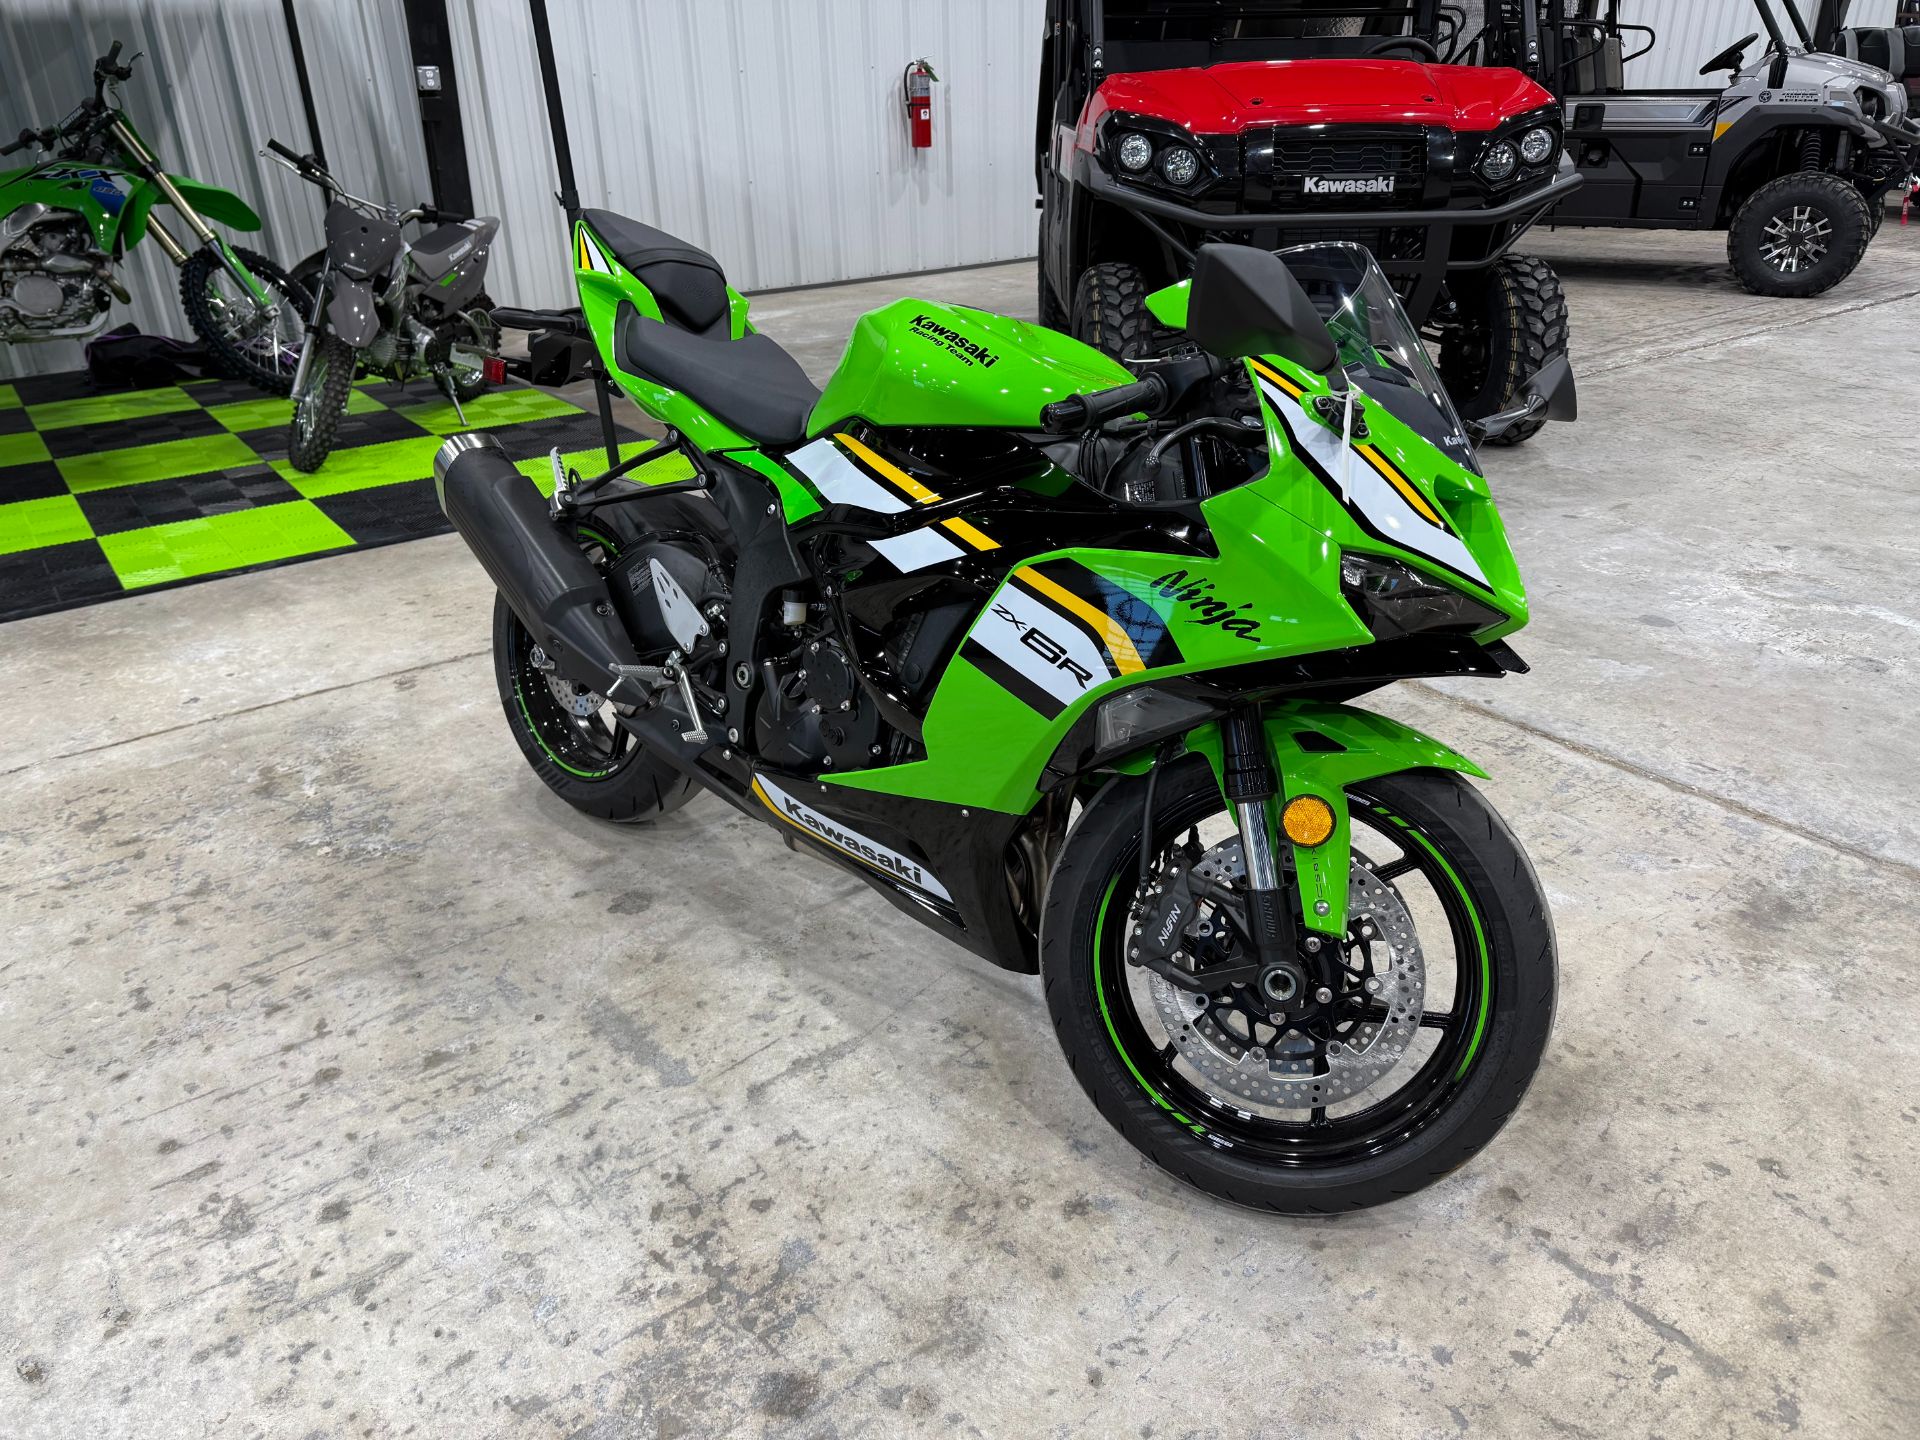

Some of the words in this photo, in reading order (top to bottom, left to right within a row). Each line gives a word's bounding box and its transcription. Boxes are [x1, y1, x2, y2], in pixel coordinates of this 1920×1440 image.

[1303, 176, 1395, 193] Kawasaki
[909, 314, 1000, 368] Kawasaki
[909, 326, 945, 346] Racing
[945, 343, 974, 367] Team
[1149, 569, 1261, 642] Ninja
[784, 796, 922, 885] Kawasaki
[1157, 903, 1183, 948] NISSIN
